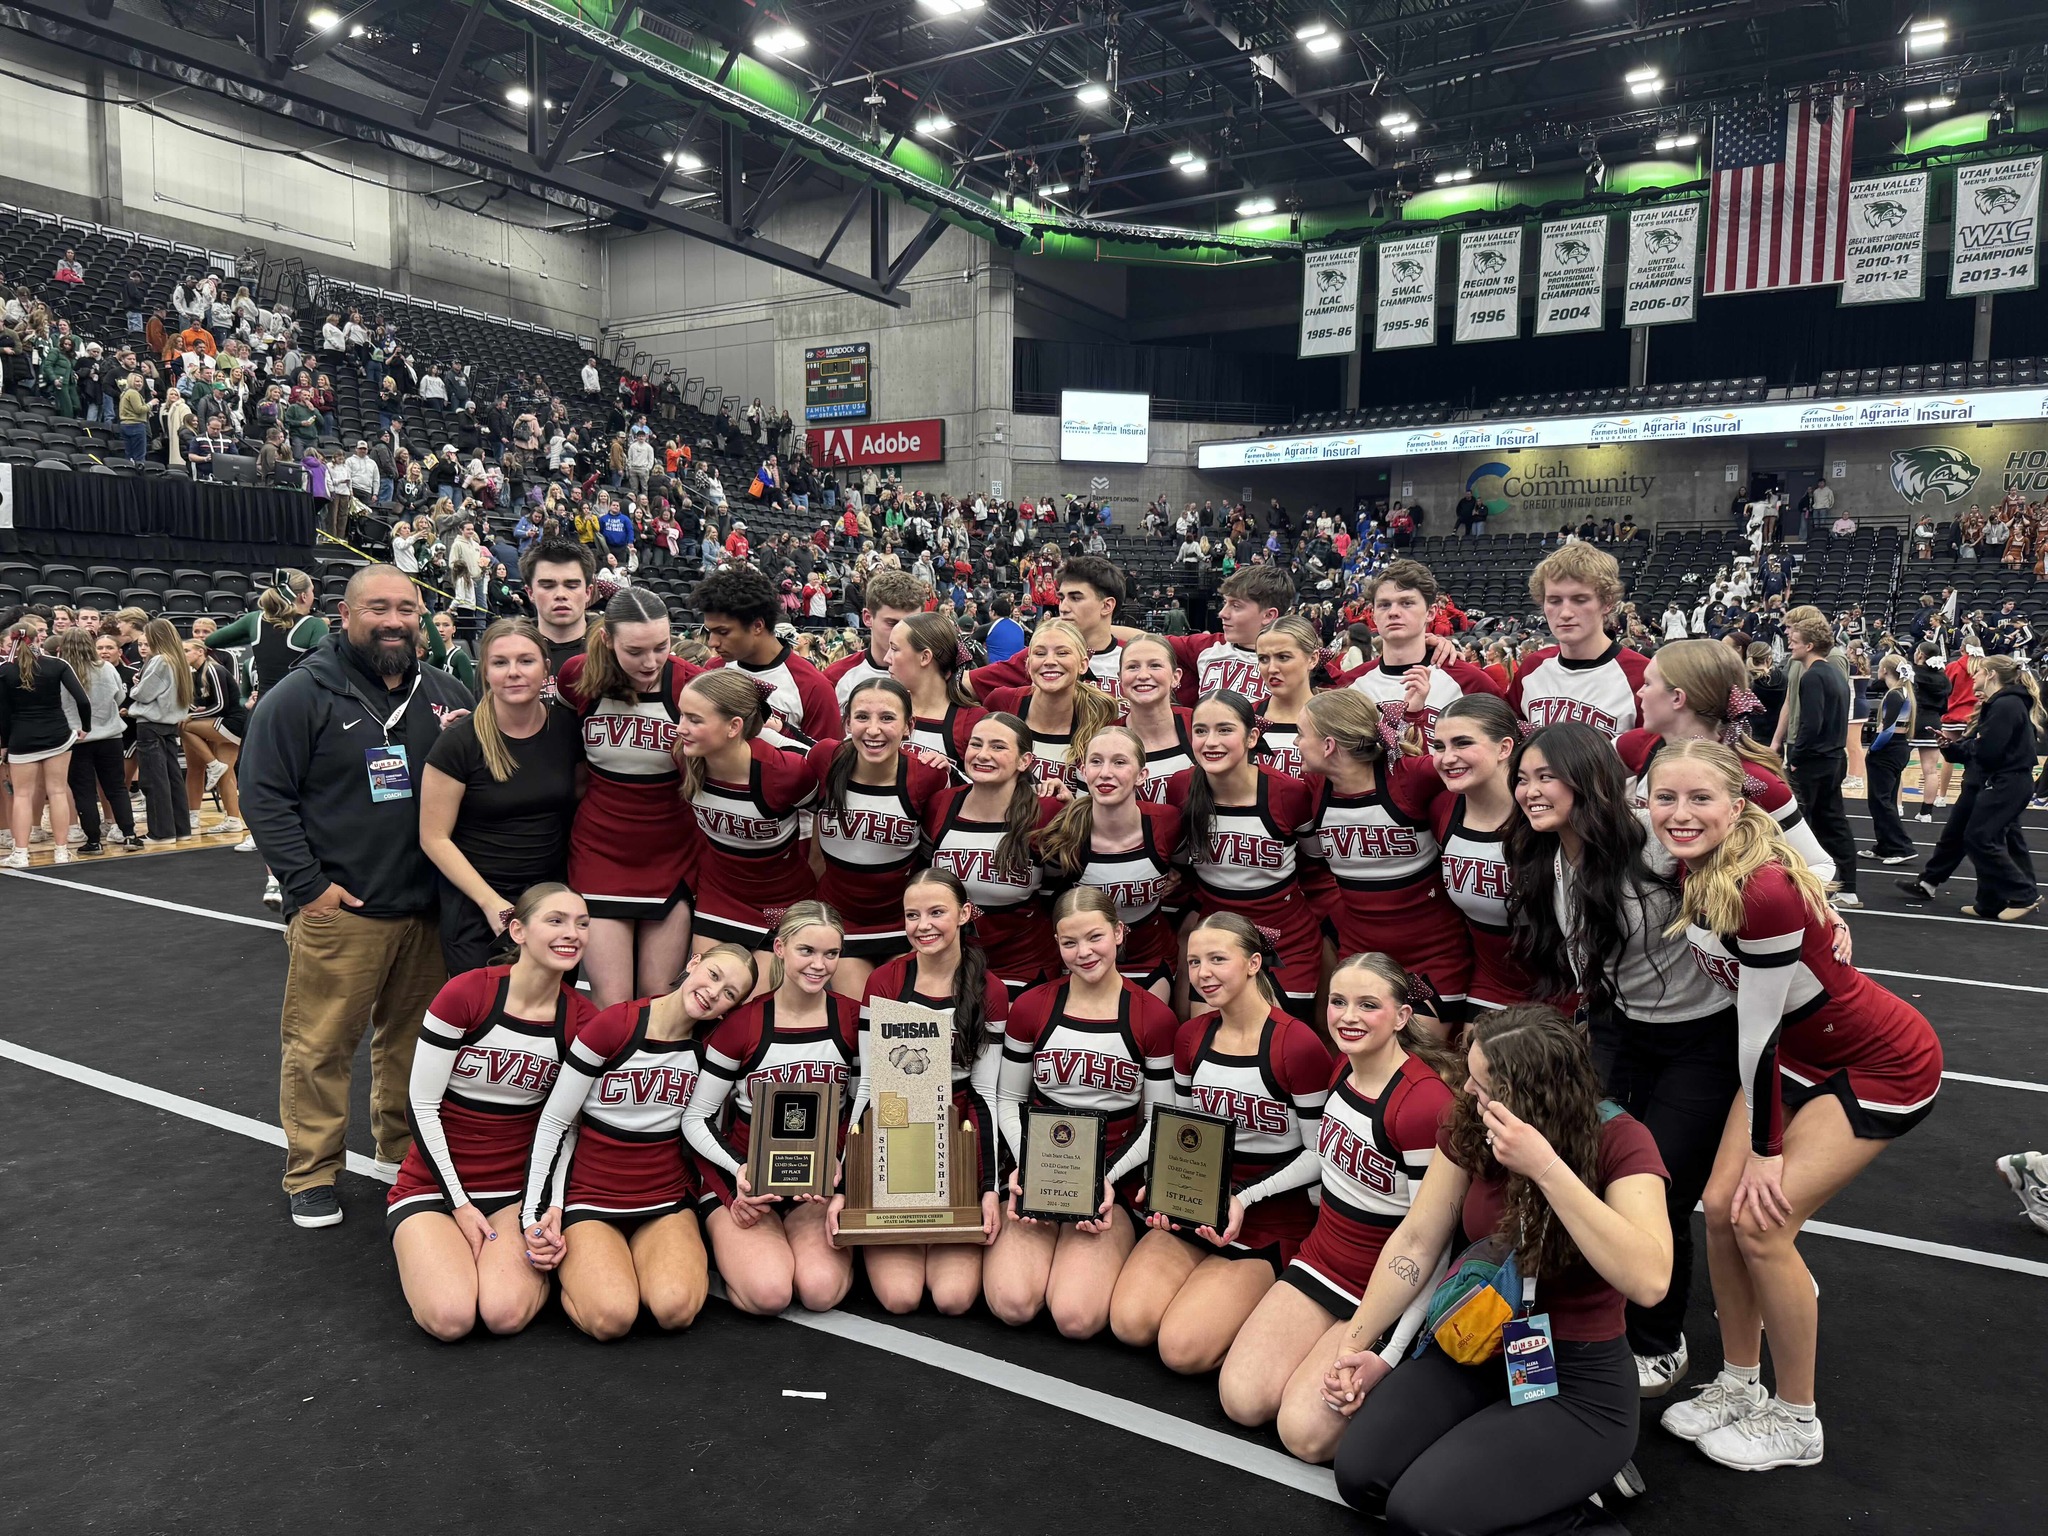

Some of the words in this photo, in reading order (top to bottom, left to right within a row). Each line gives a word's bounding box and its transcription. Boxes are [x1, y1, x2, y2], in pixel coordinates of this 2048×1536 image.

[1960, 167, 1992, 180] UTAH
[1995, 160, 2040, 174] VALLEY
[1850, 183, 1880, 194] UTAH
[1883, 177, 1925, 190] VALLEY
[1964, 178, 1987, 186] MEN'S
[1988, 171, 2035, 183] BASKETBALL
[1876, 186, 1920, 198] BASKETBALL
[1632, 212, 1659, 222] UTAH
[1661, 207, 1698, 218] VALLEY
[1655, 217, 1693, 226] BASKETBALL
[1543, 224, 1568, 233] UTAH
[1570, 219, 1605, 230] VALLEY
[1566, 228, 1600, 237] BASKETBALL
[1959, 217, 2034, 248] WAC
[1462, 235, 1485, 244] UTAH
[1488, 230, 1520, 241] VALLEY
[1483, 239, 1516, 247] BASKETBALL
[1848, 237, 1866, 246] GREAT
[1867, 235, 1884, 244] WEST
[1884, 231, 1921, 242] CONFERENCE
[1381, 246, 1403, 254] UTAH
[1405, 240, 1436, 250] VALLEY
[1401, 248, 1433, 257] BASKETBALL
[1848, 240, 1920, 256] CHAMPIONS
[1307, 255, 1328, 264] UTAH
[1329, 251, 1358, 260] VALLEY
[1648, 257, 1676, 266] UNITED
[1856, 254, 1910, 269] 2010-11
[1956, 245, 2034, 265] CHAMPIONS
[1543, 270, 1563, 278] NCAA
[1564, 267, 1595, 275] DIVISION
[1637, 263, 1686, 274] BASKETBALL
[1646, 271, 1675, 280] LEAGUE
[1959, 264, 2028, 284] 2013-14
[1463, 277, 1500, 289] REGION
[1503, 276, 1515, 285] 18
[1547, 274, 1594, 284] PROVISIONAL
[1628, 277, 1692, 290] CHAMPIONS
[1855, 270, 1908, 284] 2011-12
[1392, 284, 1423, 297] SWAC
[1460, 286, 1516, 299] CHAMPIONS
[1547, 280, 1595, 291] TOURNAMENT
[1541, 286, 1600, 300] CHAMPIONS
[1319, 295, 1342, 306] ICAC
[1380, 294, 1433, 307] CHAMPIONS
[1629, 296, 1690, 312] 2006-07
[1305, 304, 1354, 316] CHAMPIONS
[1470, 309, 1506, 324] 1996
[1549, 306, 1591, 322] 2004
[1382, 317, 1429, 332] 1995-96
[1306, 326, 1352, 340] 1985-86
[826, 346, 855, 355] MURDOCK
[1800, 415, 1831, 424] Farmers
[1832, 414, 1854, 422] Union
[1860, 406, 1910, 422] Agraria
[1917, 406, 1973, 421] Insural
[1591, 428, 1618, 436] Farmers
[1643, 420, 1686, 435] Agraria
[1692, 419, 1741, 434] Insural
[1800, 421, 1854, 429] INSURANCE
[861, 431, 921, 455] Adobe
[1452, 434, 1491, 446] Agraria
[1496, 432, 1539, 446] Insural
[1285, 445, 1318, 458] Agraria
[1323, 445, 1361, 458] Insural
[2004, 450, 2048, 470] HO
[1524, 460, 1570, 480] Utah
[1836, 468, 1842, 476] 2
[1503, 471, 1656, 498] Community
[1523, 499, 1556, 510] CREDIT
[1561, 498, 1591, 509] UNION
[1594, 496, 1632, 507] CENTER
[1199, 658, 1271, 700] CVH
[583, 713, 679, 752] CVHS
[818, 808, 917, 846] CVHS
[1315, 825, 1420, 859] CVHS
[1190, 831, 1284, 871] VHS
[1076, 873, 1168, 908] VHS
[881, 1022, 940, 1039] UHSAA
[1033, 1049, 1140, 1094] CVHS
[937, 1085, 946, 1198] CHAMPIONSHIP
[1316, 1113, 1397, 1195] VHS
[1053, 1189, 1079, 1197] PLACE
[1166, 1191, 1178, 1200] 1ST
[1179, 1194, 1203, 1206] PLACE
[1512, 1338, 1547, 1351] UHSAA
[1524, 1388, 1546, 1400] COACH
